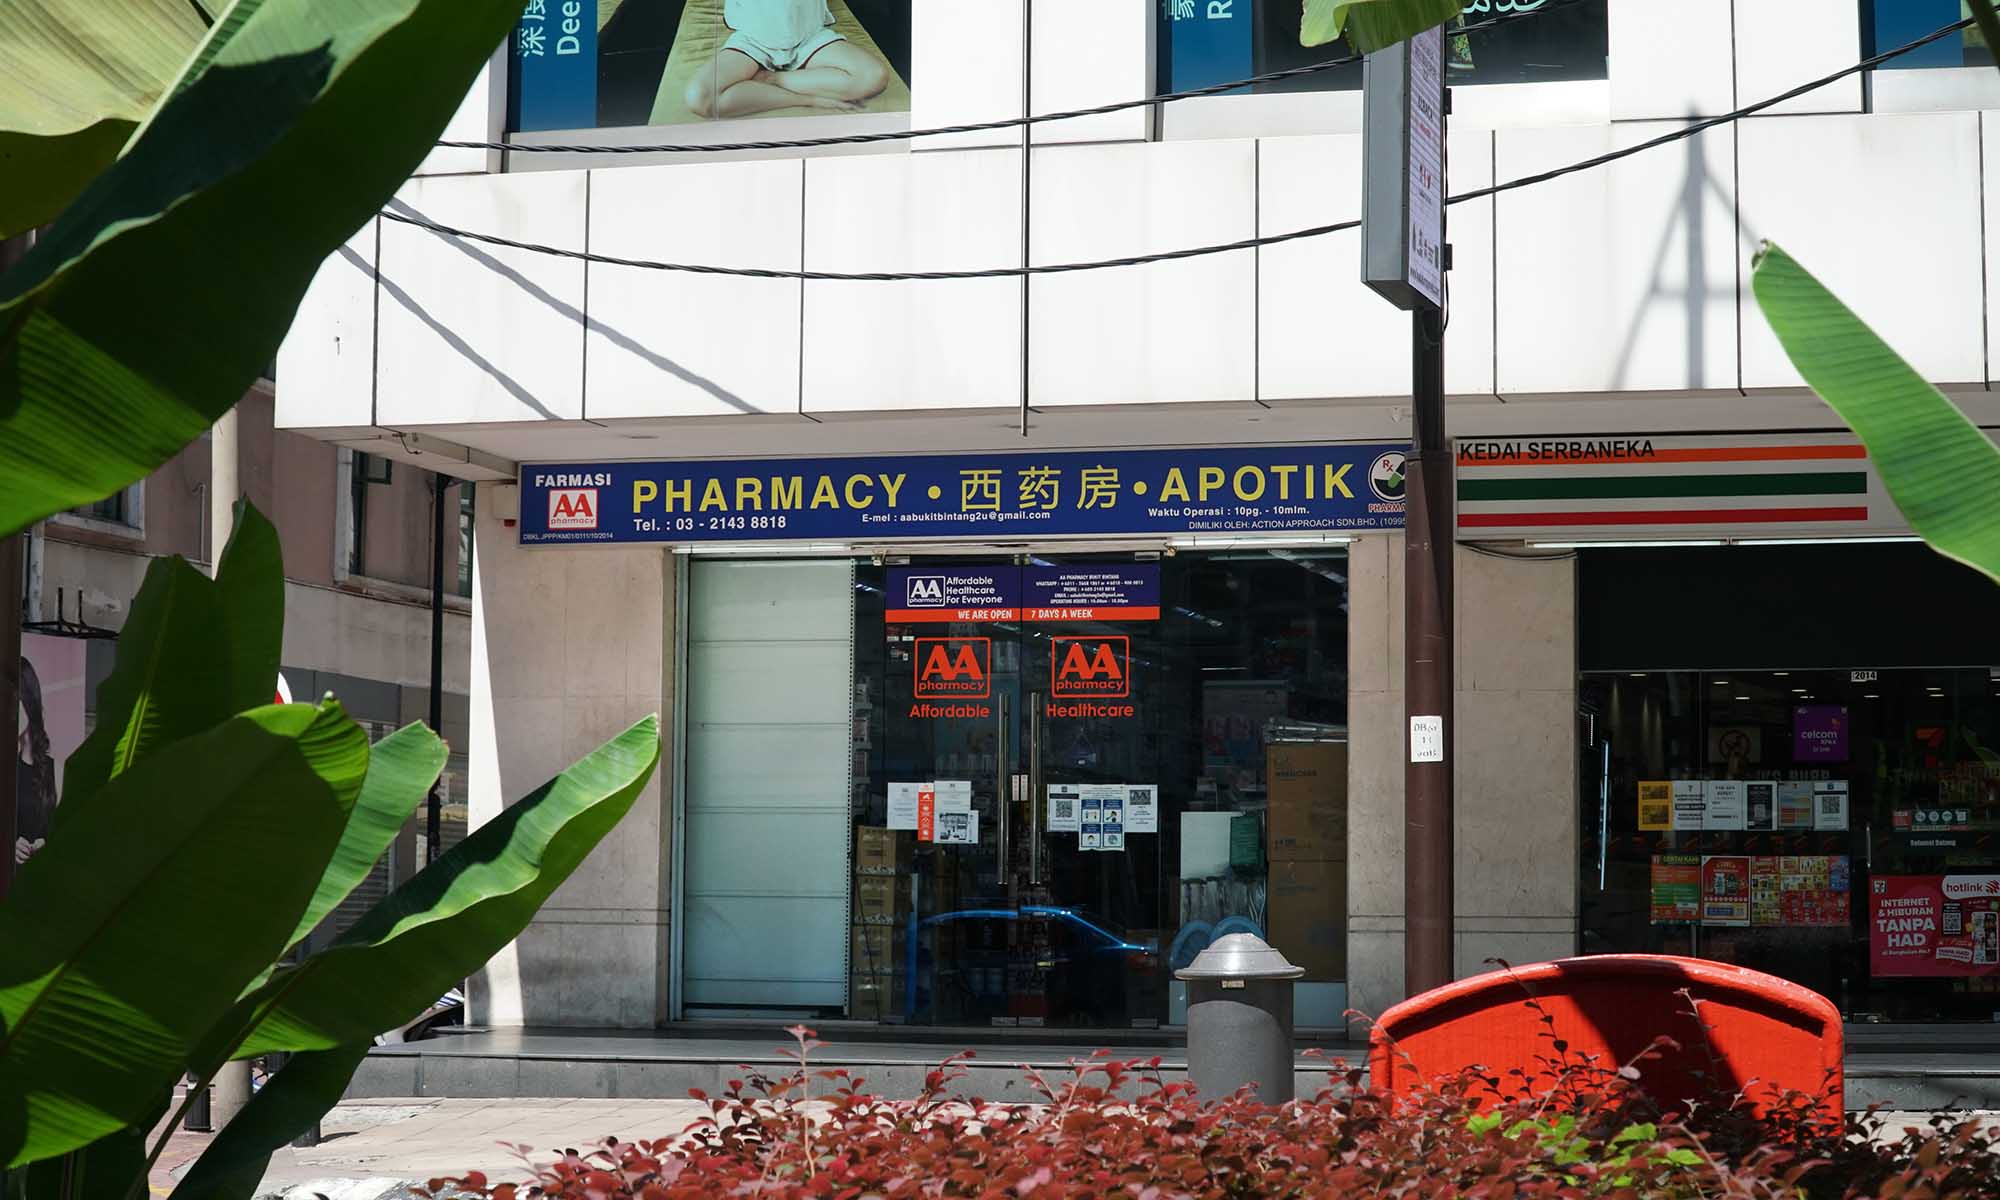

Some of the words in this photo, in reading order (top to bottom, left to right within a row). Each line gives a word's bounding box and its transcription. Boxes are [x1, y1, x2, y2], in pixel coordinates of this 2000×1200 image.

[1459, 442, 1521, 460] KEDAI
[1527, 440, 1655, 459] SERBANEKA
[535, 473, 611, 487] FARMASI
[1159, 463, 1354, 502] APOTIK
[632, 473, 906, 513] PHARMACY
[959, 464, 1121, 512] 西药房
[553, 493, 593, 517] AA
[862, 513, 890, 522] E-mel
[900, 511, 1050, 522] aabukitbintang2u@gmail.com
[1148, 507, 1179, 517] Waktu
[1183, 507, 1224, 518] Operasi
[1234, 506, 1262, 517] 10pg.
[633, 519, 661, 531] Tel.
[675, 518, 693, 531] 03
[709, 517, 745, 530] 2143
[750, 516, 786, 529] 8818
[1188, 521, 1222, 529] DIMILIKI
[1224, 520, 1250, 529] OLEH:
[1251, 520, 1285, 529] ACTION
[1285, 519, 1334, 528] APPROACH
[946, 576, 993, 585] Affordable
[910, 579, 942, 598] AA
[946, 586, 995, 595] Healthcare
[946, 596, 960, 604] For
[961, 596, 1003, 605] Everyone
[957, 610, 971, 619] WE
[972, 610, 989, 619] ARE
[990, 609, 1012, 619] OPEN
[1031, 610, 1036, 618] 7
[1038, 609, 1060, 618] DAYS
[1061, 609, 1068, 618] A
[1070, 609, 1093, 618] WEEK
[921, 645, 984, 680] AA
[1058, 643, 1122, 680] AA
[918, 680, 985, 691] pharmacy
[1056, 680, 1124, 690] pharmacy
[910, 703, 991, 718] Affordable
[1047, 702, 1135, 718] Healthcare
[1801, 730, 1838, 739] celcom
[1946, 882, 1983, 893] hotlink
[1881, 897, 1930, 907] INTERNET
[1878, 909, 1885, 917] &
[1887, 907, 1934, 917] HIBURAN
[1877, 917, 1936, 933] TANPA
[1887, 933, 1926, 947] HAD
